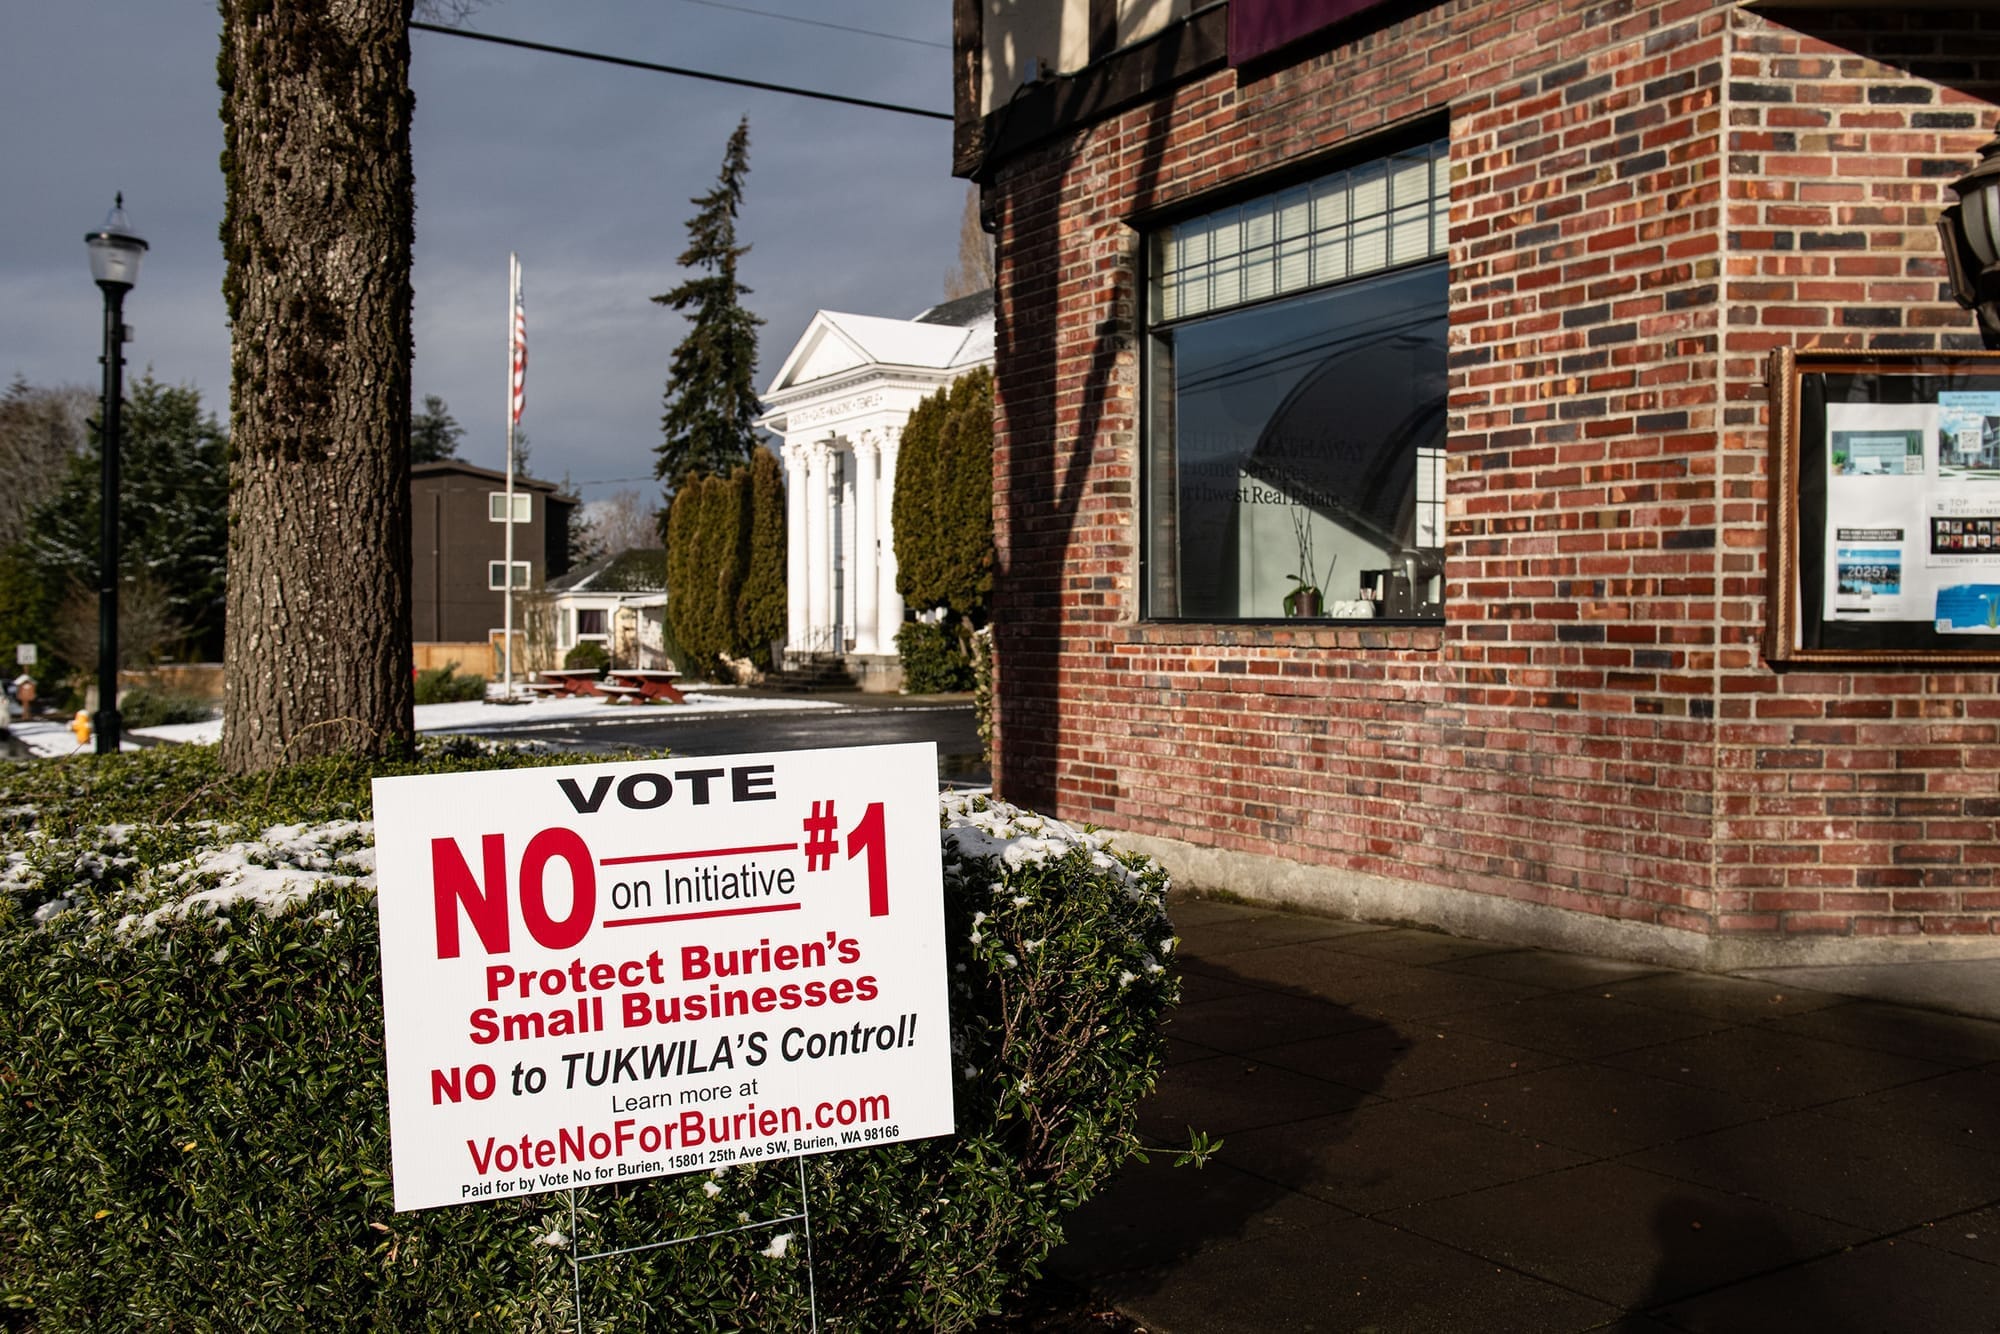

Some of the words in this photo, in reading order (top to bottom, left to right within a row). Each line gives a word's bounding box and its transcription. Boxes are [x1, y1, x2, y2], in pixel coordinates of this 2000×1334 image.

[1252, 486, 1287, 504] Real
[1847, 566, 1888, 579] 2025?
[557, 765, 777, 814] VOTE
[431, 826, 597, 960] NO
[611, 877, 652, 910] on
[665, 863, 796, 905] Initiative
[802, 799, 890, 918] #1
[486, 950, 665, 1002] Protect
[681, 931, 861, 981] Burien’s
[469, 991, 604, 1045] Small
[622, 975, 880, 1029] Businesses
[430, 1063, 497, 1106] NO
[511, 1061, 547, 1097] to
[561, 1031, 768, 1090] TUKWILA’S
[781, 1013, 918, 1063] Control!
[612, 1088, 672, 1114] Learn
[679, 1082, 732, 1106] more
[738, 1078, 759, 1097] at
[461, 1182, 492, 1198] Paid
[495, 1179, 516, 1193] for
[519, 1177, 536, 1192] by
[538, 1172, 569, 1187] Vote
[572, 1168, 592, 1183] No
[594, 1166, 614, 1180] for
[617, 1160, 664, 1177] Burien,
[668, 1153, 704, 1169] 15801
[708, 1147, 736, 1163] 25th
[739, 1146, 763, 1159] Ave
[766, 1140, 790, 1155] SW,
[793, 1134, 838, 1151] Burien,
[840, 1130, 862, 1145] WA
[864, 1124, 900, 1141] 98166
[466, 1094, 890, 1176] VoteNoForBurien.com
